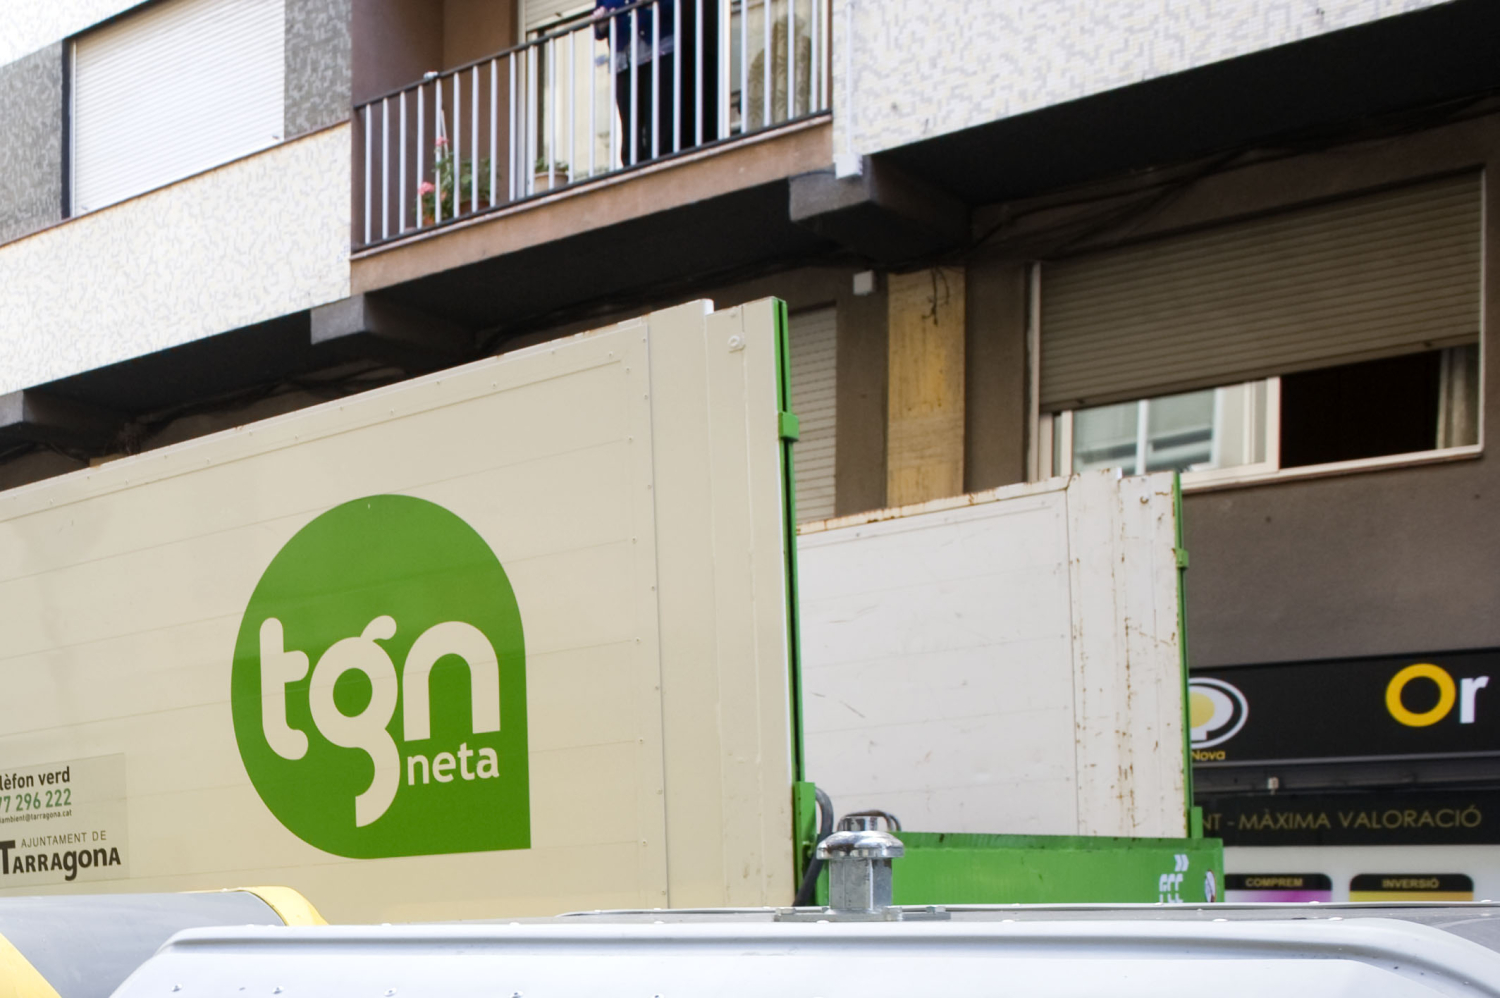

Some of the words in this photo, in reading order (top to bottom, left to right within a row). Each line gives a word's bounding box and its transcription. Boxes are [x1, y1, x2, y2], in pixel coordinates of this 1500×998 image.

[1385, 663, 1490, 727] Or
[259, 615, 500, 827] tgn
[407, 742, 500, 786] neta
[1192, 749, 1226, 761] Nova
[38, 765, 71, 786] verd
[15, 791, 41, 812] 296
[45, 787, 72, 808] 222
[1238, 805, 1331, 830] MÀXIMA
[1338, 804, 1482, 828] VALORACIÓ
[21, 832, 87, 848] AJUNTAMENT
[92, 830, 106, 841] DE
[1245, 877, 1303, 888] COMPREM
[1382, 878, 1440, 889] INVERSIÓ
